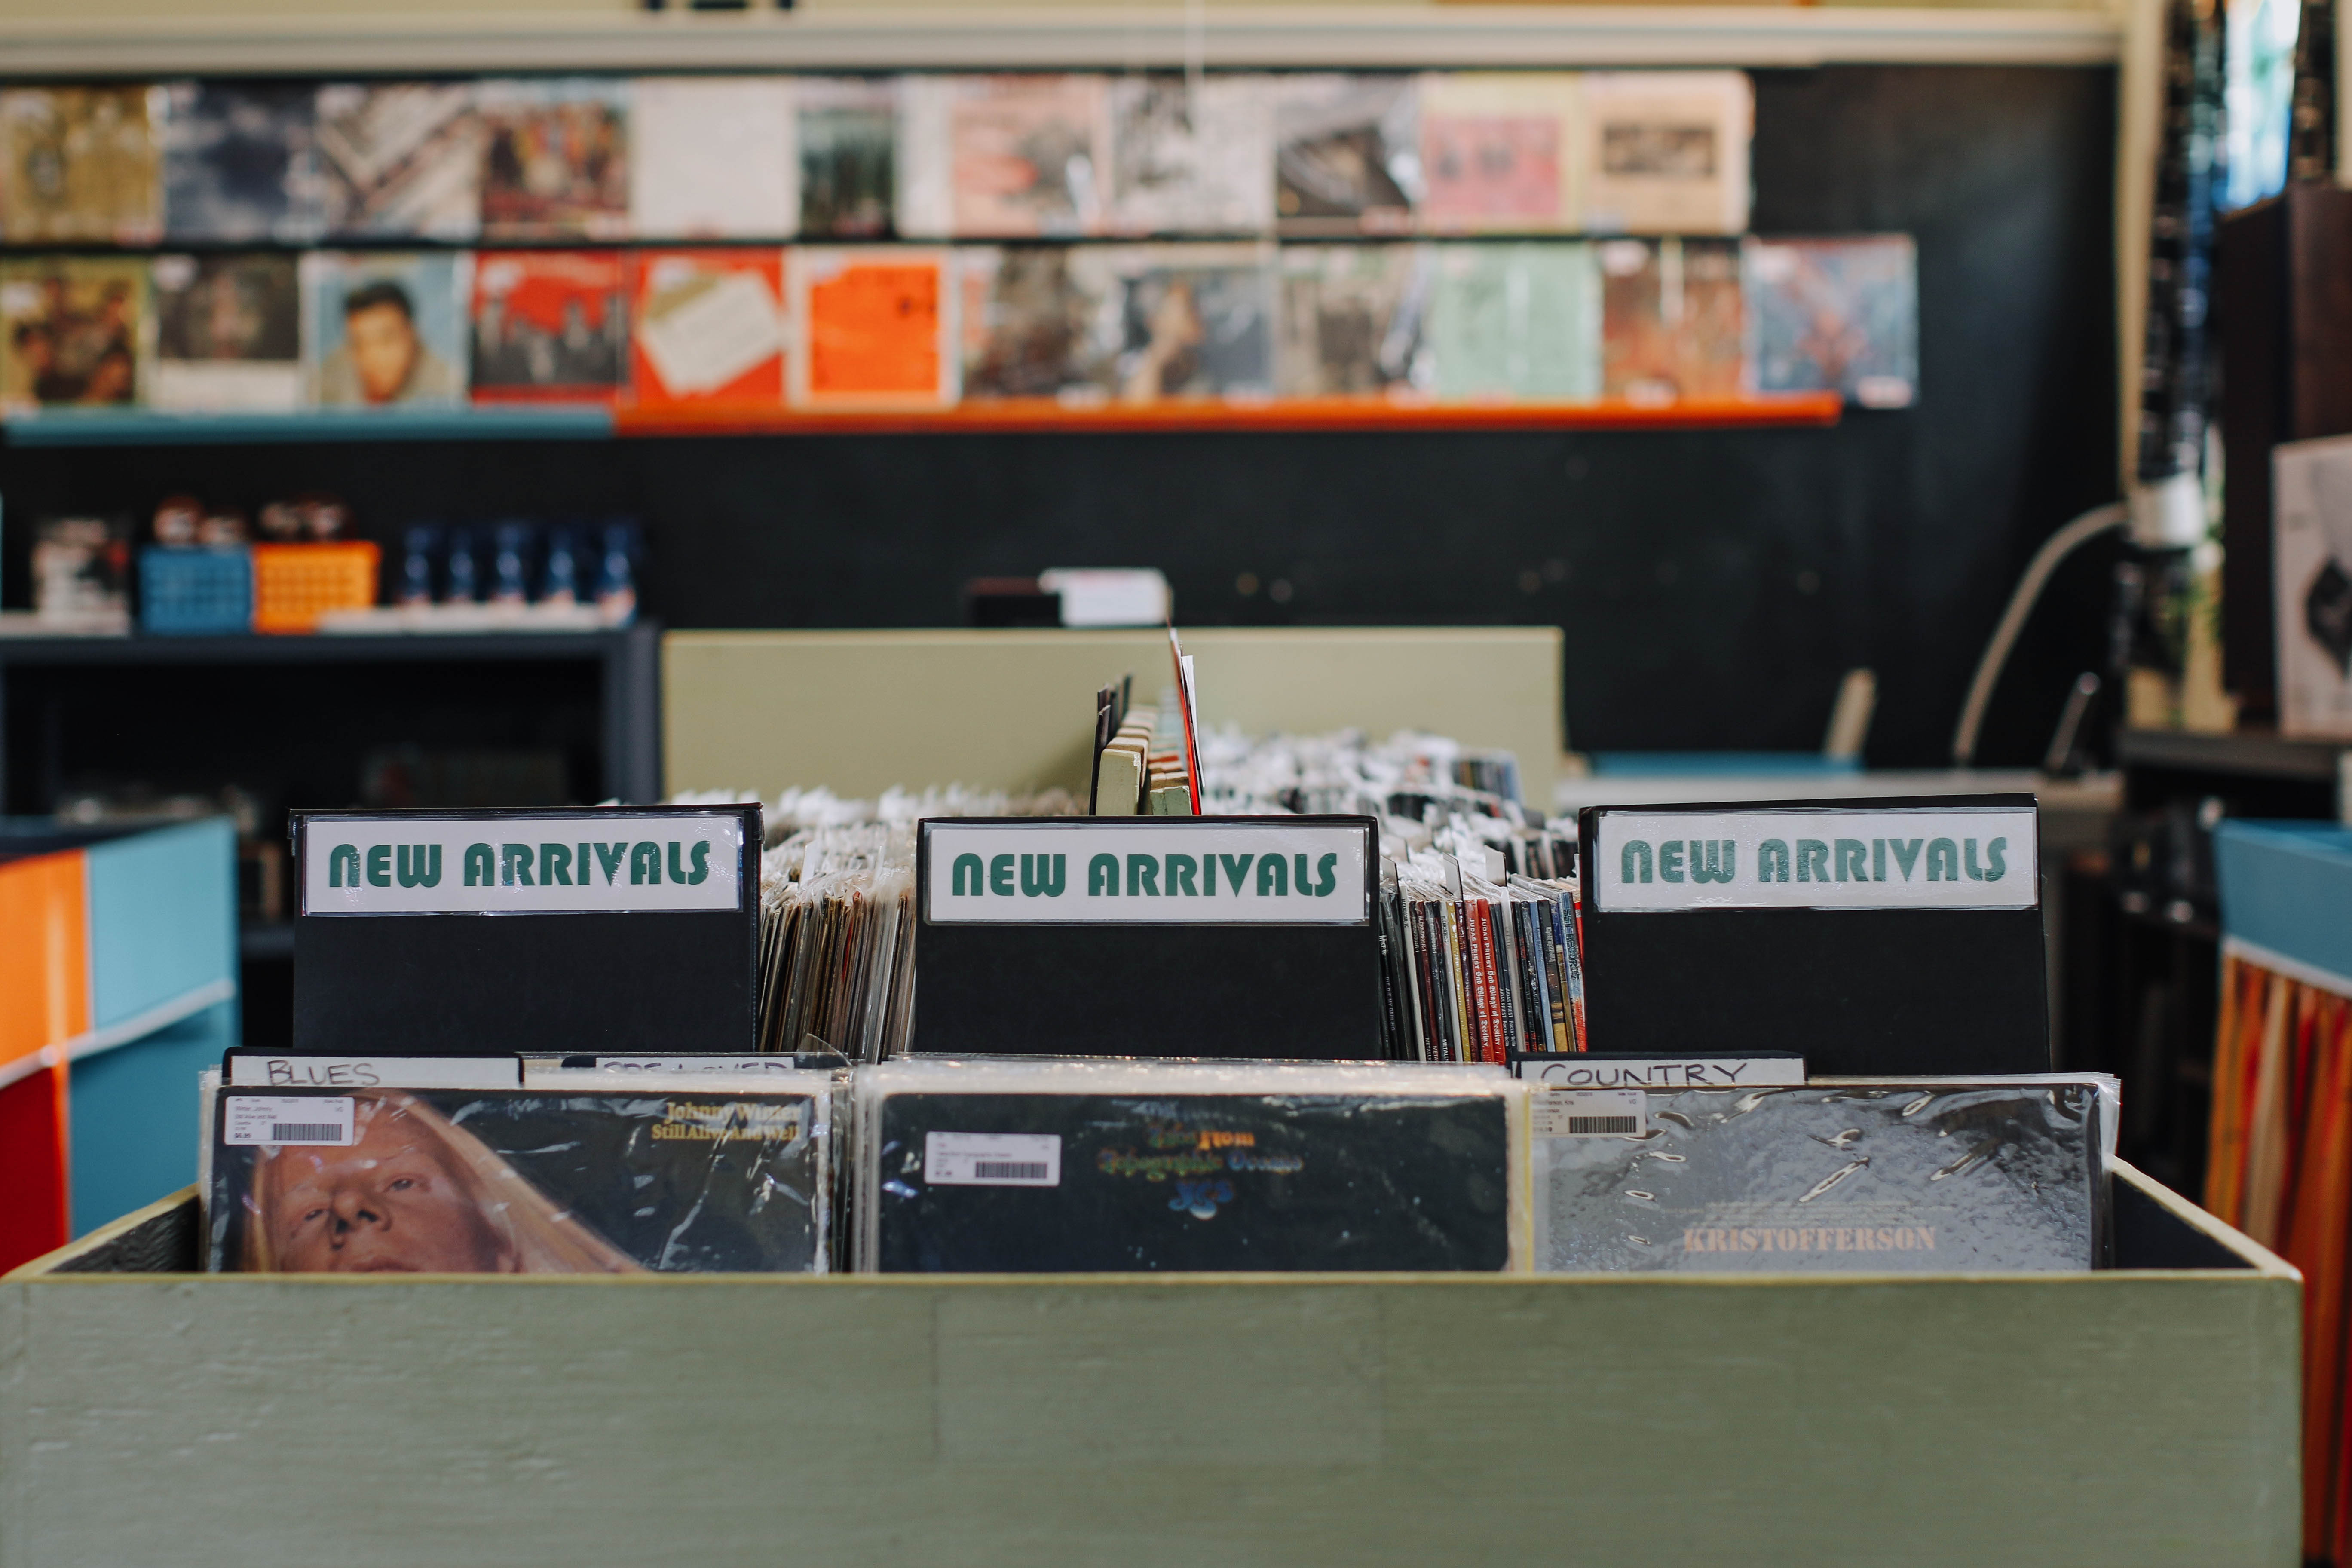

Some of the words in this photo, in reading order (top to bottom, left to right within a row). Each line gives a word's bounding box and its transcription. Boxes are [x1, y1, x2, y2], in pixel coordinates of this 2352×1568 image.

[330, 842, 442, 888] NEW
[464, 840, 710, 887] ARRIVALS
[1621, 839, 1735, 884] NEW
[1758, 837, 2006, 882] ARRIVALS
[952, 852, 1066, 897] NEW
[1088, 852, 1337, 897] ARRIVALS
[1472, 943, 1480, 969] PRIEST
[1484, 943, 1492, 968] PRIEST
[1566, 934, 1580, 980] RECORDS
[1387, 998, 1393, 1007] MY
[267, 1060, 380, 1086] BLUES
[1541, 1063, 1747, 1086] COUNTRY
[664, 1101, 734, 1125] Johnny
[735, 1102, 802, 1121] Winter
[651, 1123, 685, 1140] Still
[686, 1124, 729, 1140] Alive
[731, 1124, 762, 1140] And
[1682, 1227, 1936, 1252] KRISTOFFERSON
